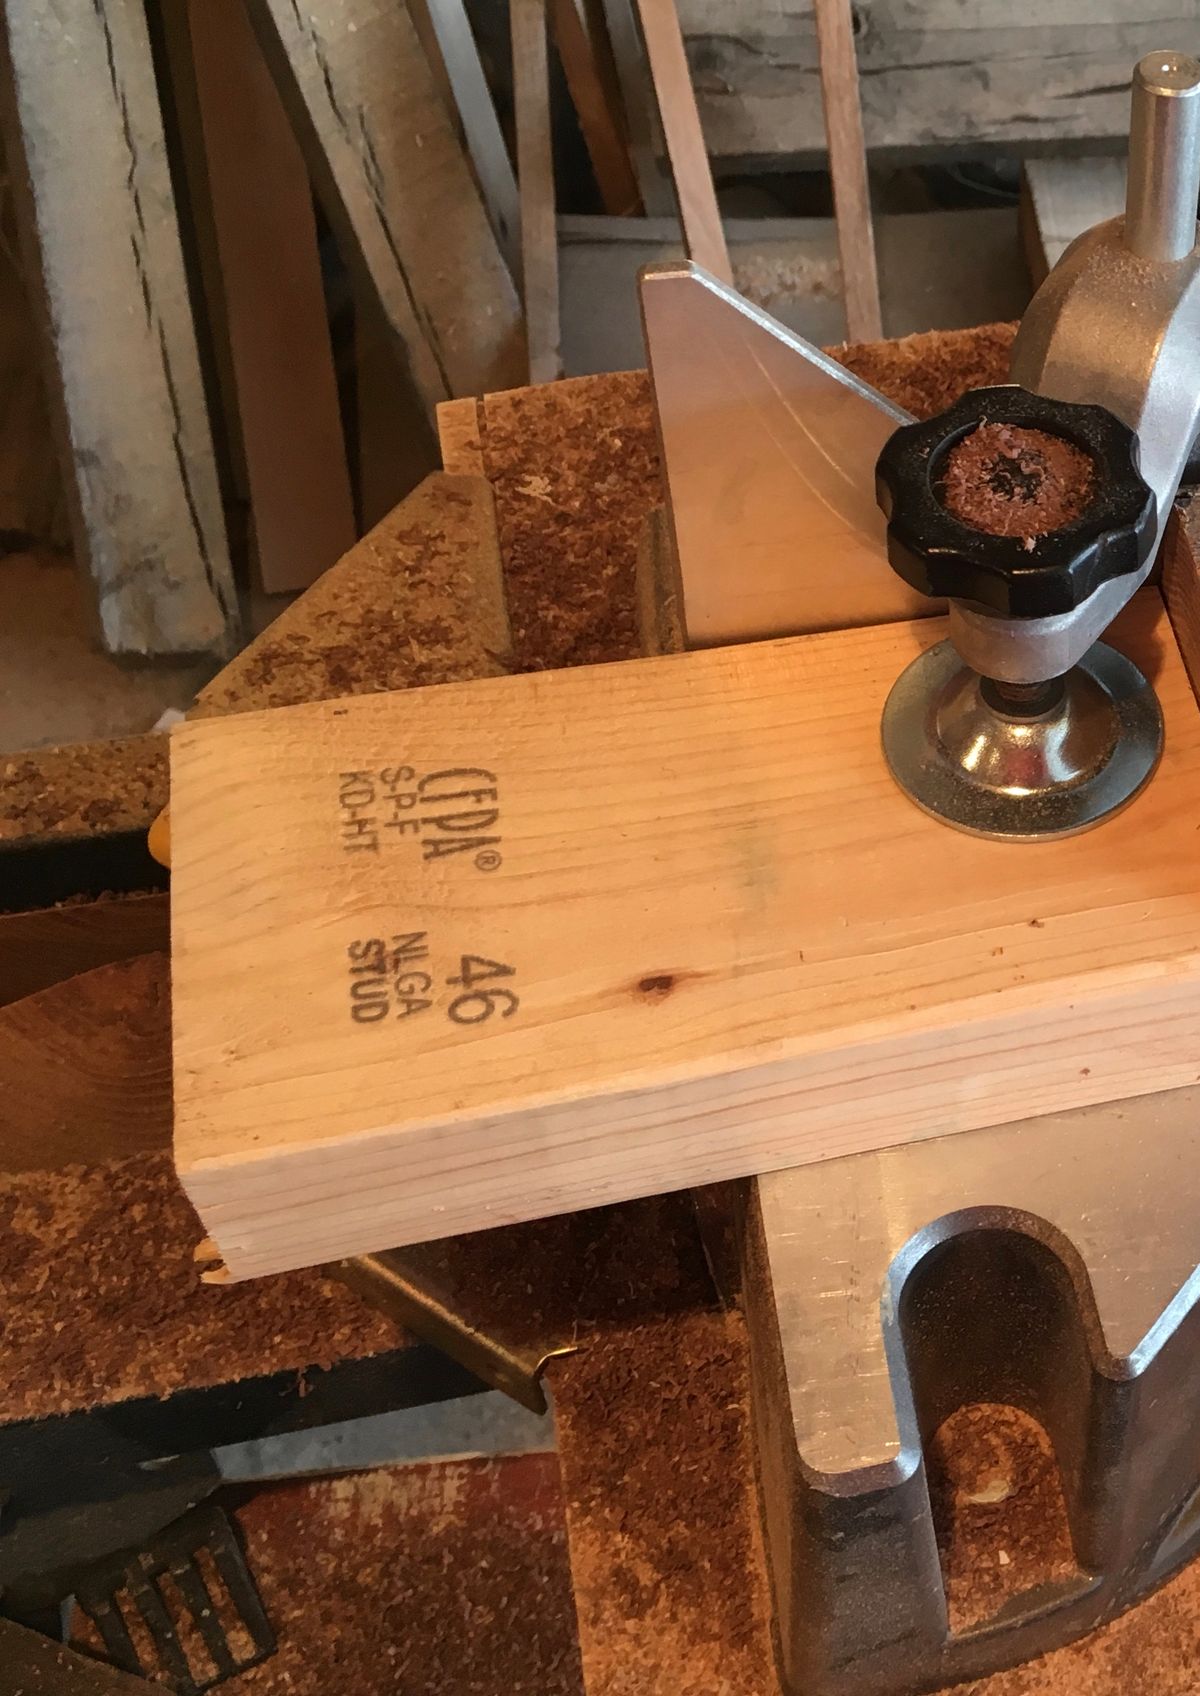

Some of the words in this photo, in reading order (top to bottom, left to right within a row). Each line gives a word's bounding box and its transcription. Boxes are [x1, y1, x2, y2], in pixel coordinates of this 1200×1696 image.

[347, 938, 390, 1023] STUD
[392, 931, 433, 1020] NLGA
[445, 954, 520, 1024] 46
